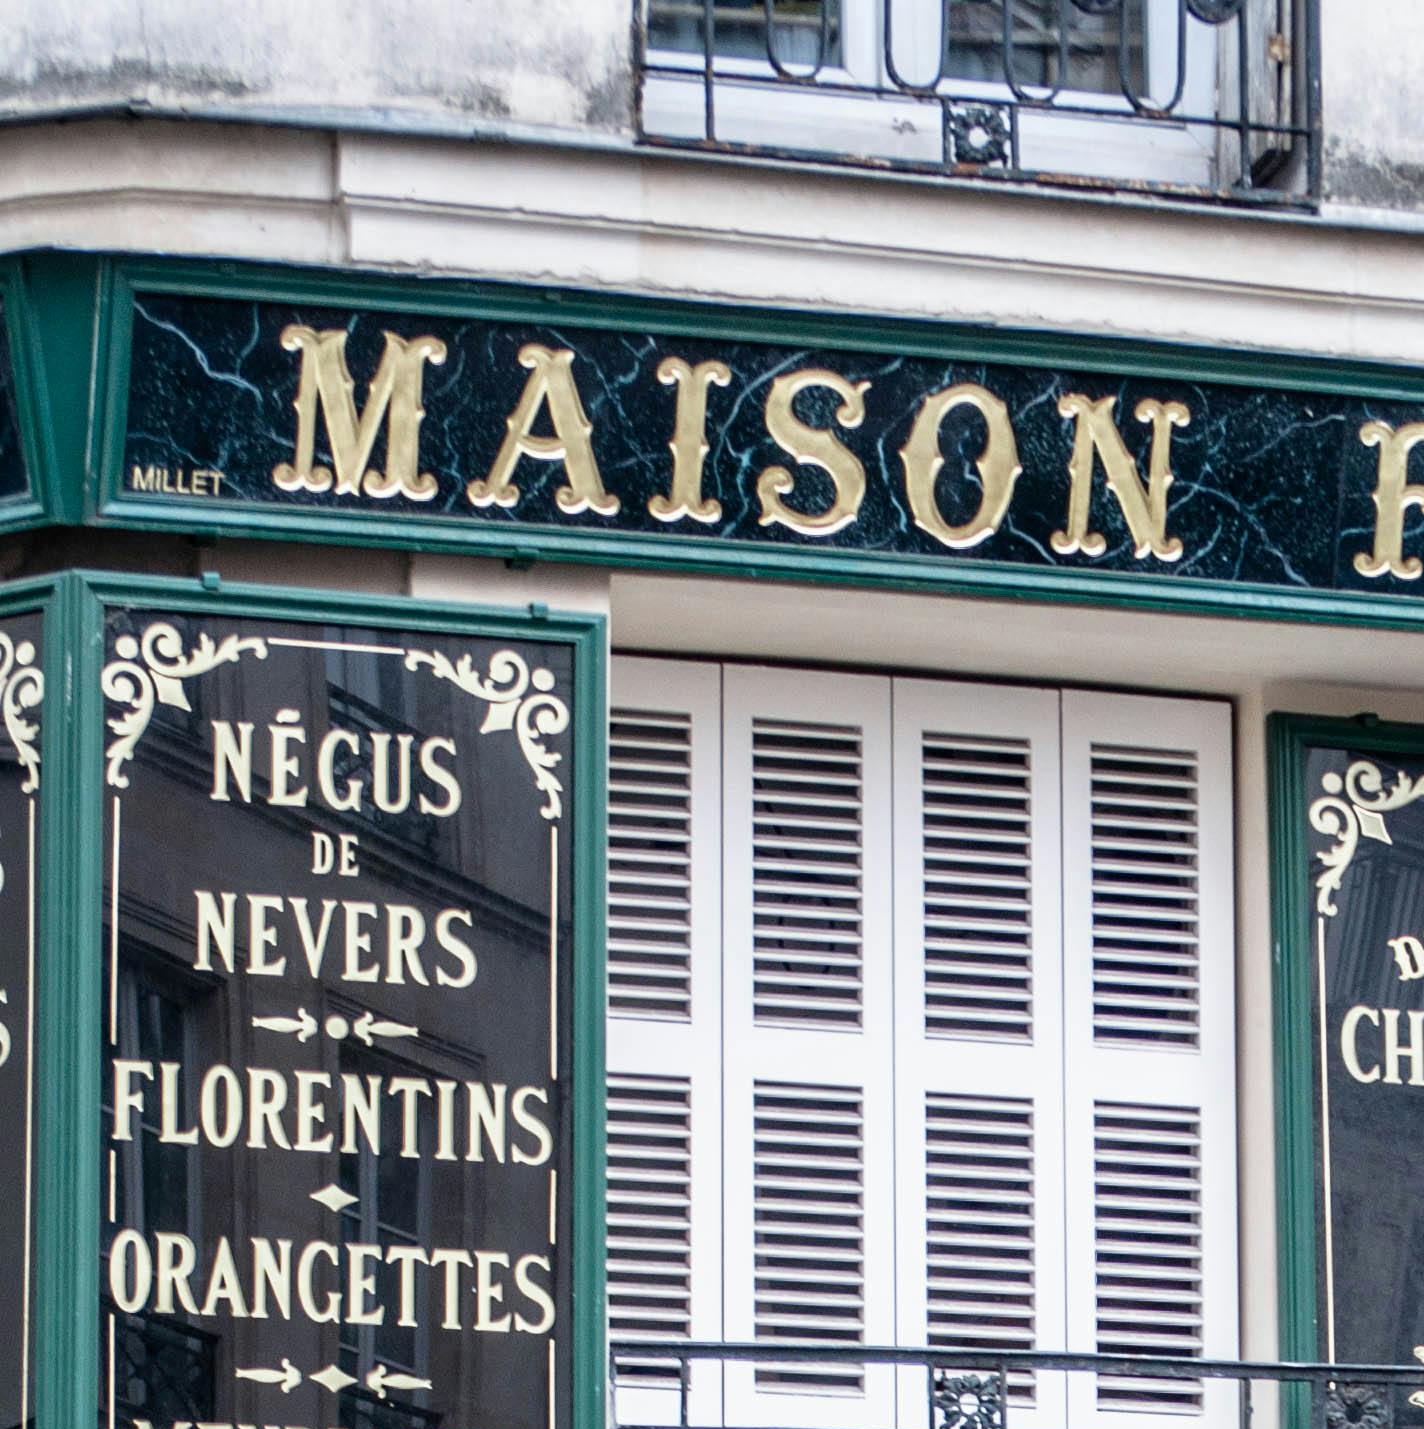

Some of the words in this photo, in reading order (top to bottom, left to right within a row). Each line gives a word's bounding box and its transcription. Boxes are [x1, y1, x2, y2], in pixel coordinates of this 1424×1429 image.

[131, 466, 225, 497] MILLET
[273, 323, 1190, 563] MAISON
[210, 709, 462, 818] NÉGUS
[311, 832, 360, 877] DE
[193, 890, 479, 989] NEVERS
[111, 1059, 553, 1167] FLORENTINS
[109, 1227, 556, 1335] ORANGETTES
